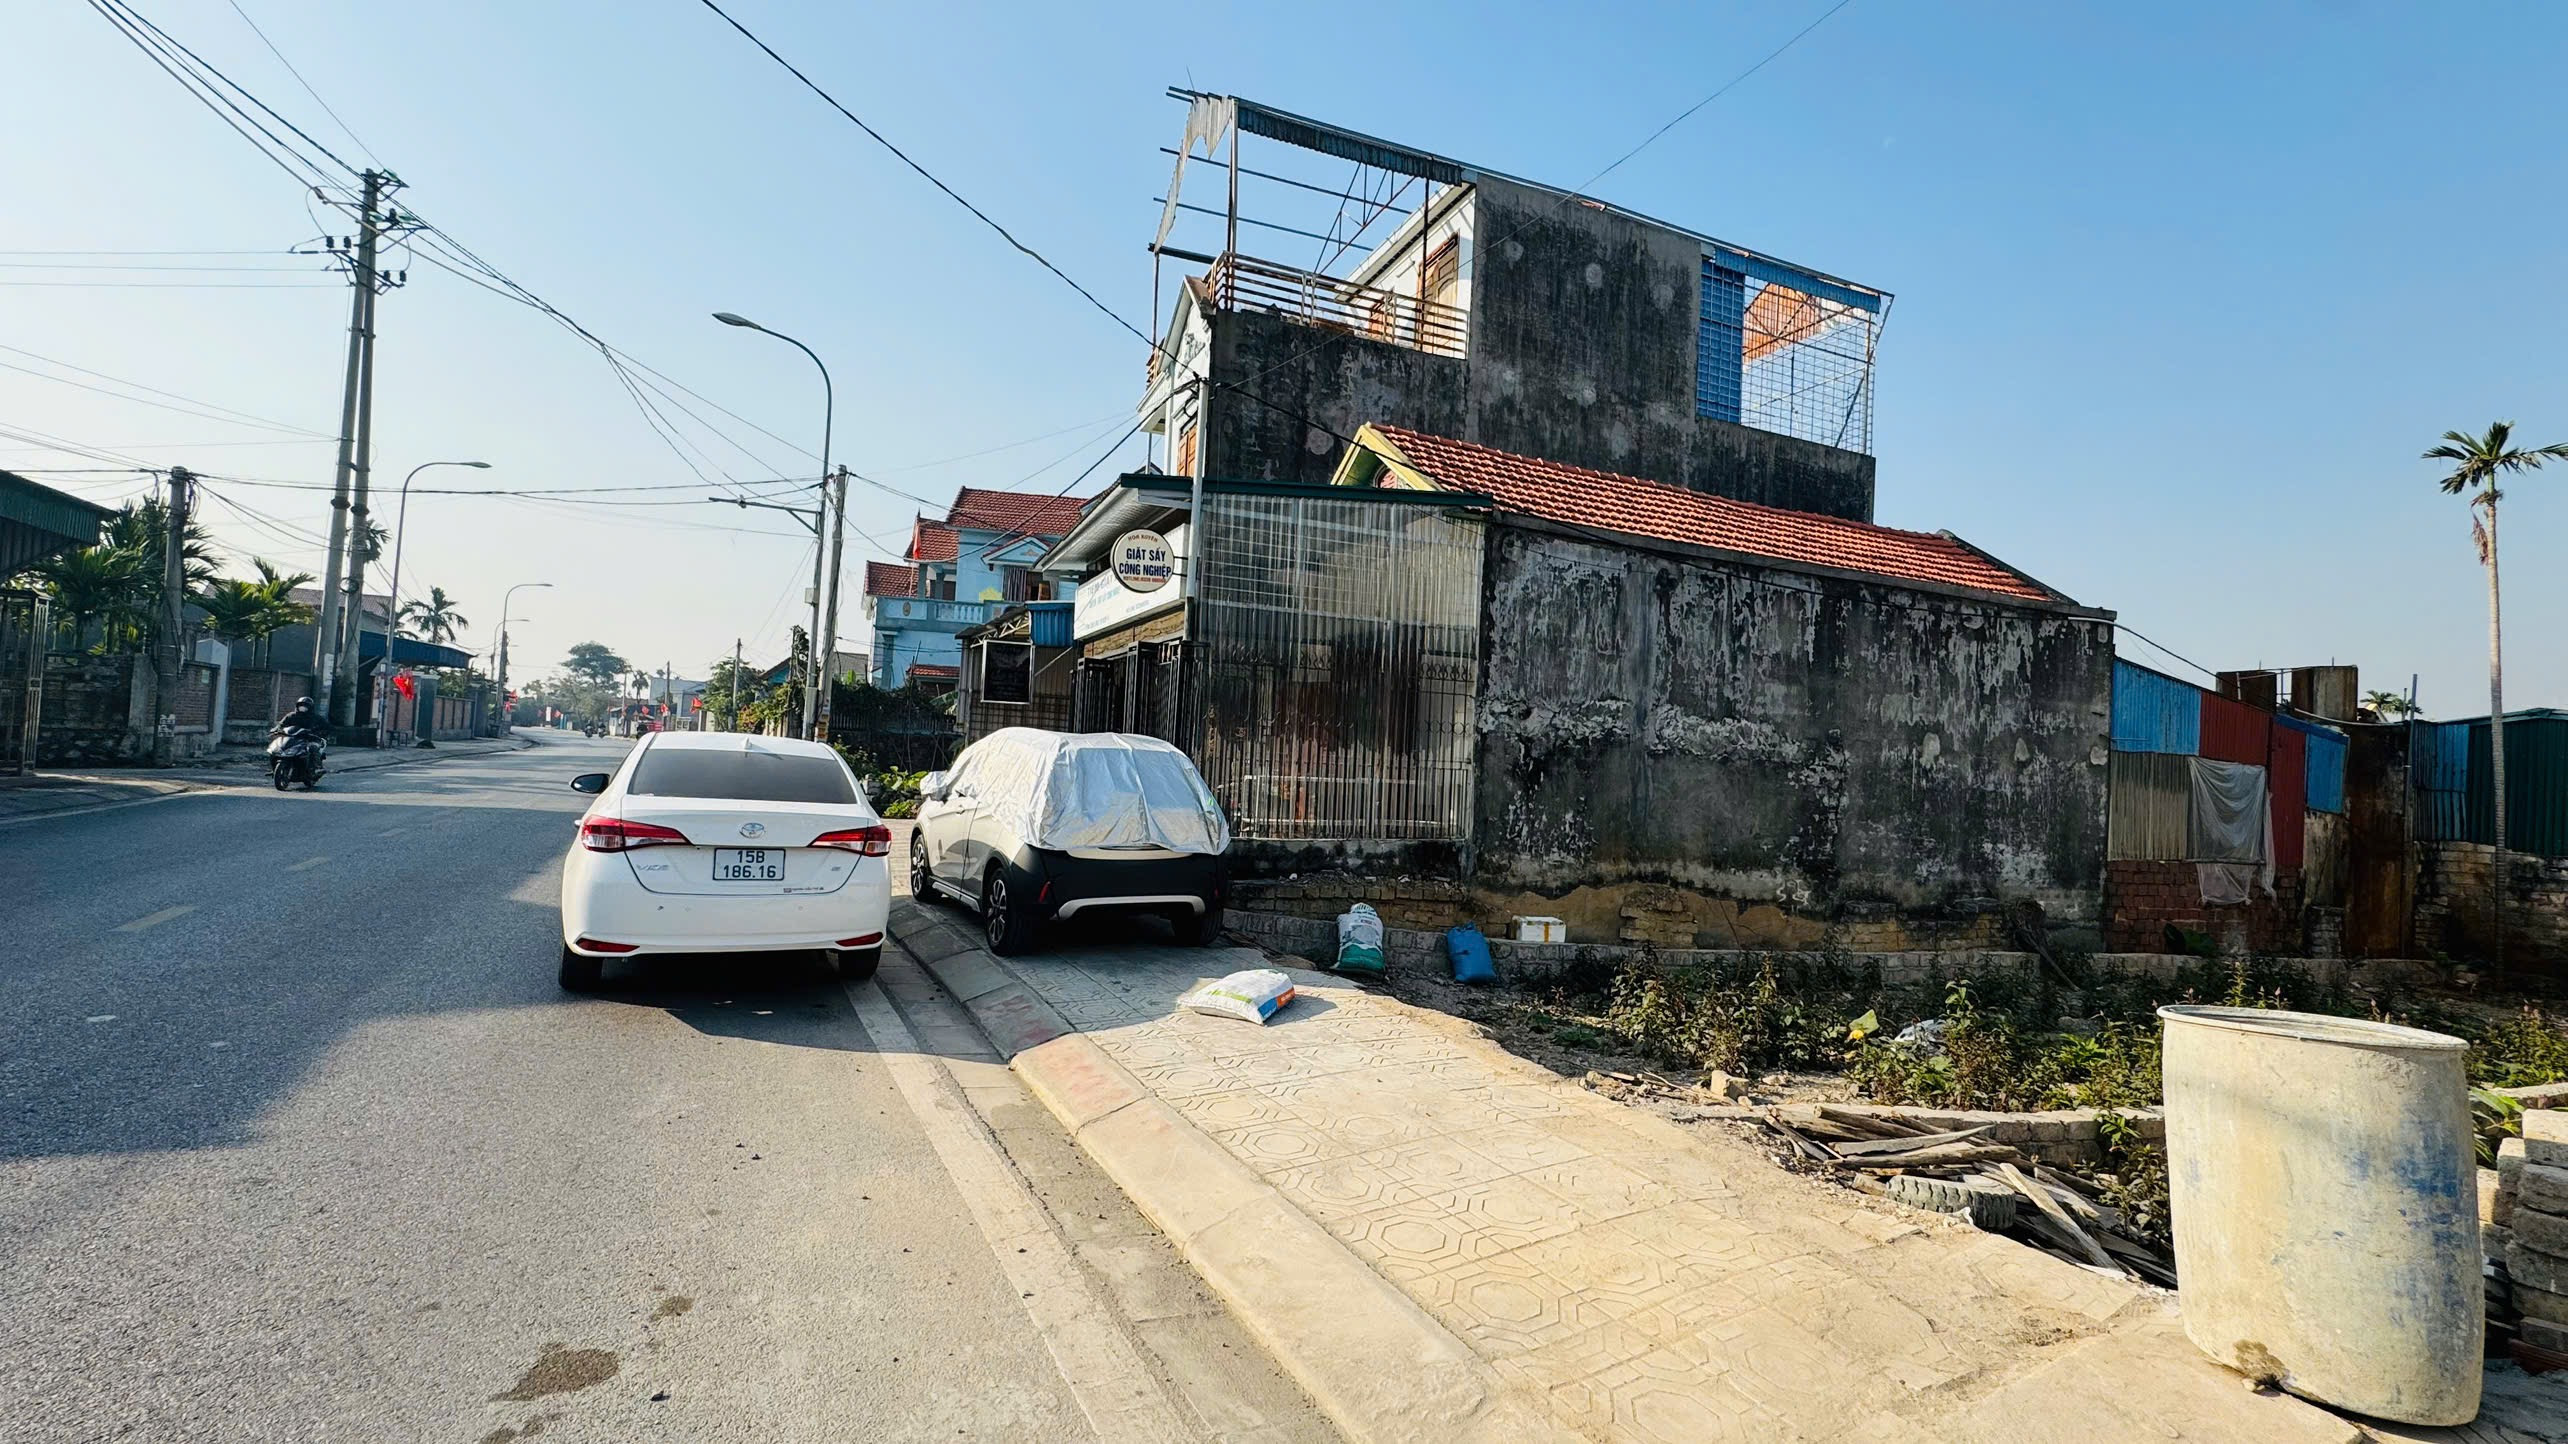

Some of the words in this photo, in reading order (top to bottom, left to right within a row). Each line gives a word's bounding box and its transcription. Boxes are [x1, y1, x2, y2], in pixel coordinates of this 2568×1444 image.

[1126, 546, 1147, 562] GIẶT
[1149, 546, 1166, 562] SẤY
[1119, 561, 1141, 576] CÔNG
[1143, 564, 1172, 578] NGHIỆP
[737, 850, 765, 863] 15B
[723, 865, 776, 878] 186.16
